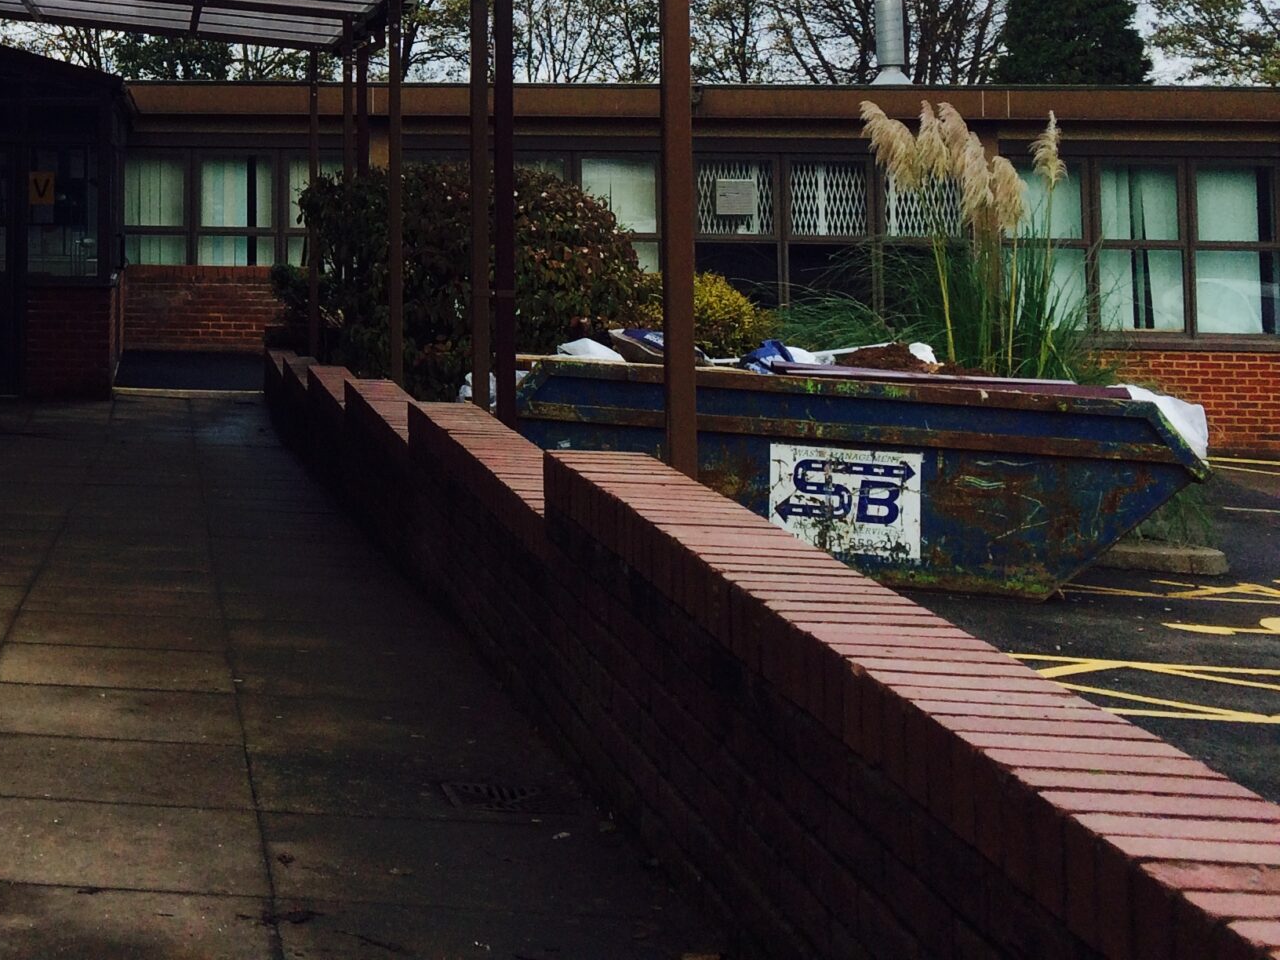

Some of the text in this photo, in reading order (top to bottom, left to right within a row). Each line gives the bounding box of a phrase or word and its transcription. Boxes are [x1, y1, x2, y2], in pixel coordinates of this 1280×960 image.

[34, 178, 50, 198] V
[775, 458, 915, 525] SB
[793, 521, 849, 534] RECNG
